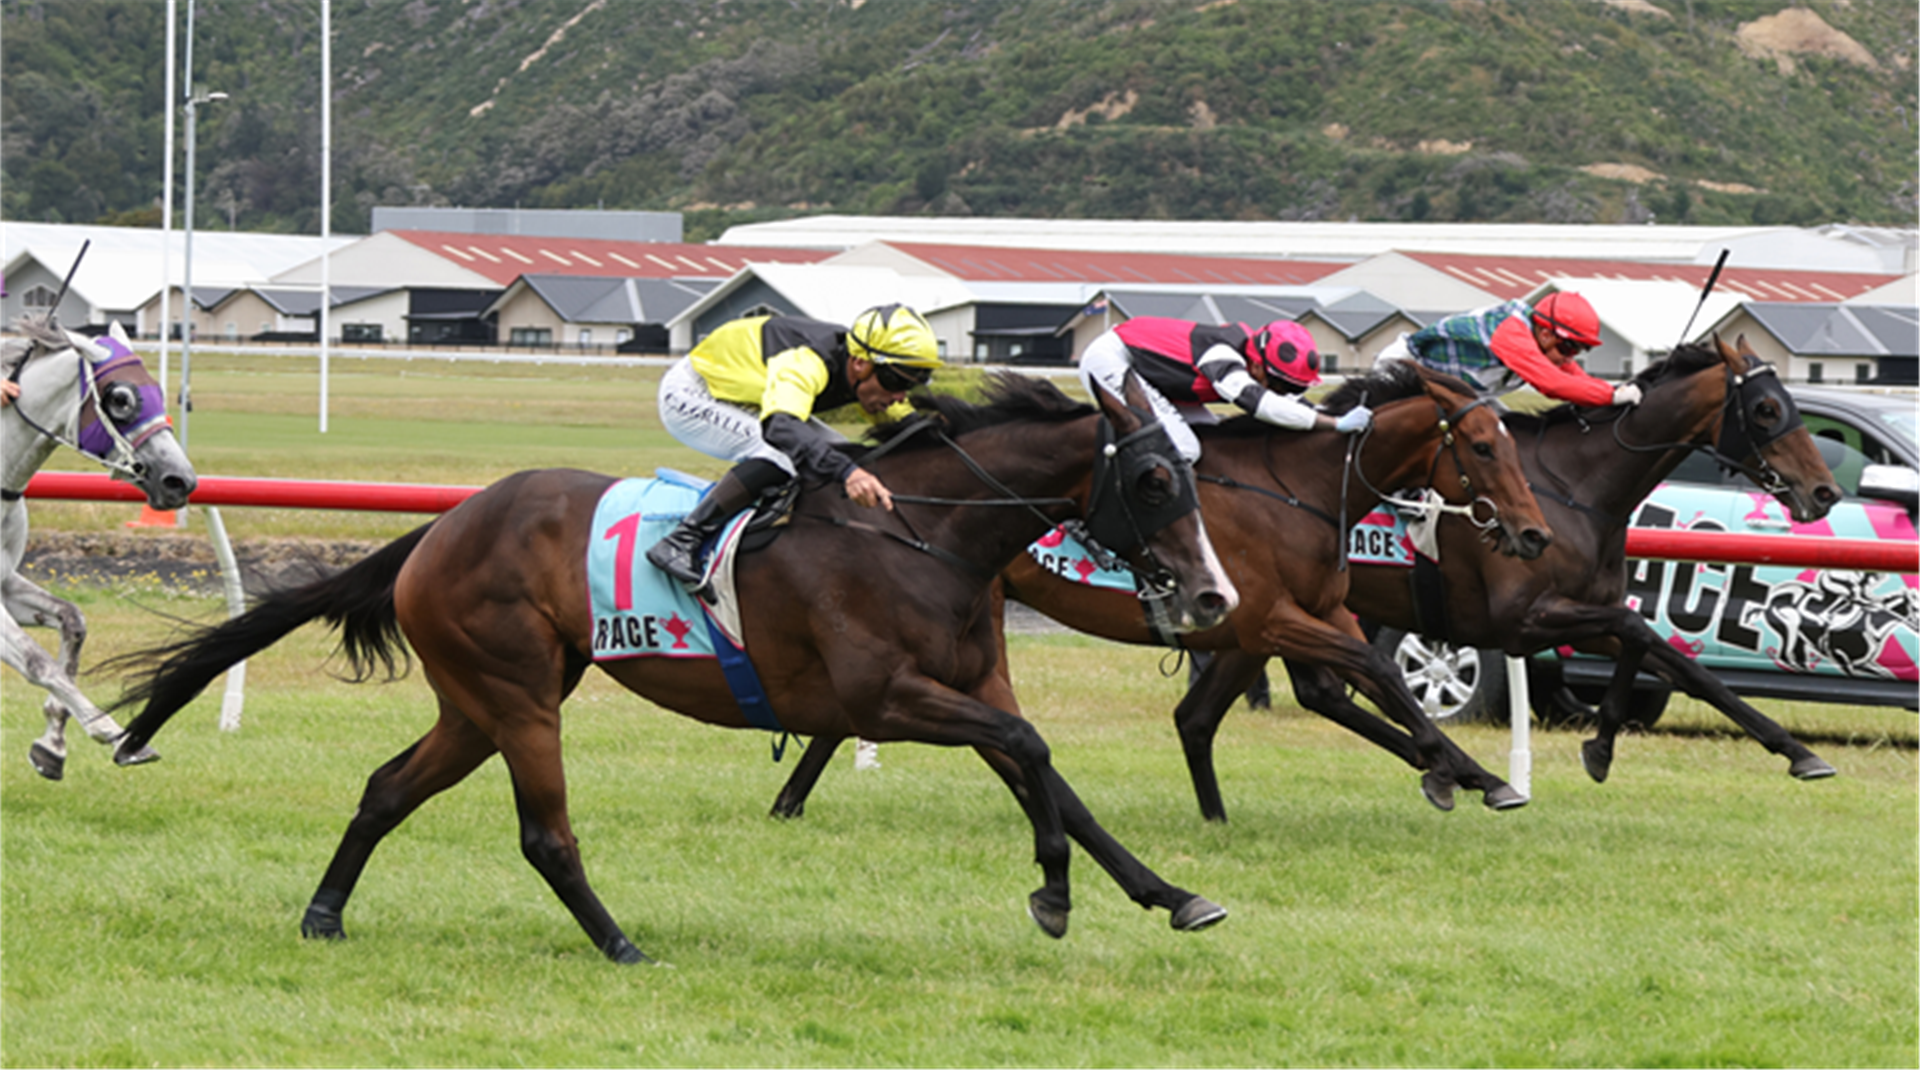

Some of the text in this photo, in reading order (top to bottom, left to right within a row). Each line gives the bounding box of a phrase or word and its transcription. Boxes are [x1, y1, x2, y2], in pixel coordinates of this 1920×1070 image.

[1347, 528, 1396, 558] ACE
[603, 512, 641, 610] 1
[595, 615, 660, 650] RACE
